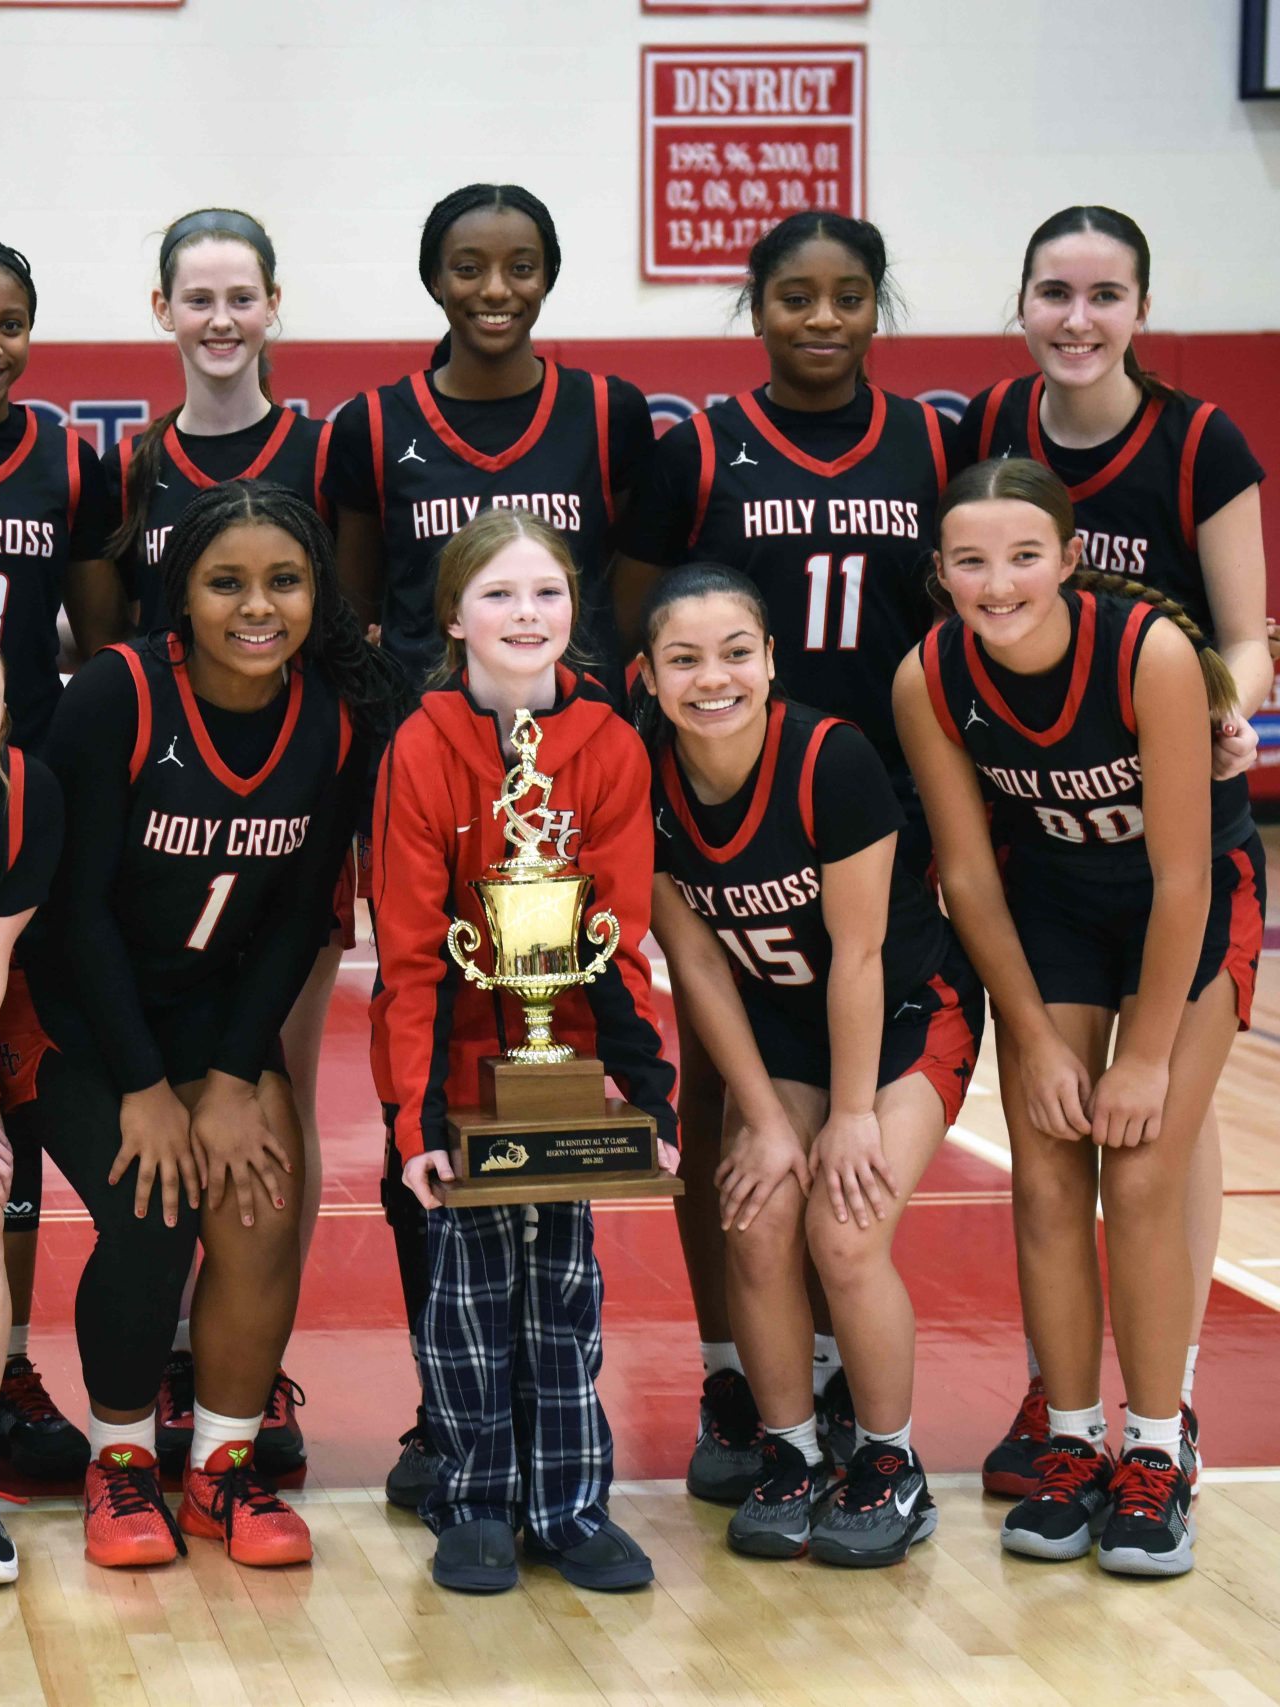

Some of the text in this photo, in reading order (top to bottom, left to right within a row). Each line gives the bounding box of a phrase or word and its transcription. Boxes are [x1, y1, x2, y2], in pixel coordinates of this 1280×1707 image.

[672, 66, 837, 113] DISTRICT
[412, 495, 481, 540] HOLY
[743, 498, 919, 540] HOLY CROSS
[1074, 527, 1148, 575] ROSS
[804, 552, 868, 652] 11
[142, 809, 311, 857] HOLY CROSS
[184, 871, 239, 951] 1
[723, 866, 820, 918] CROSS
[715, 924, 817, 987] 15
